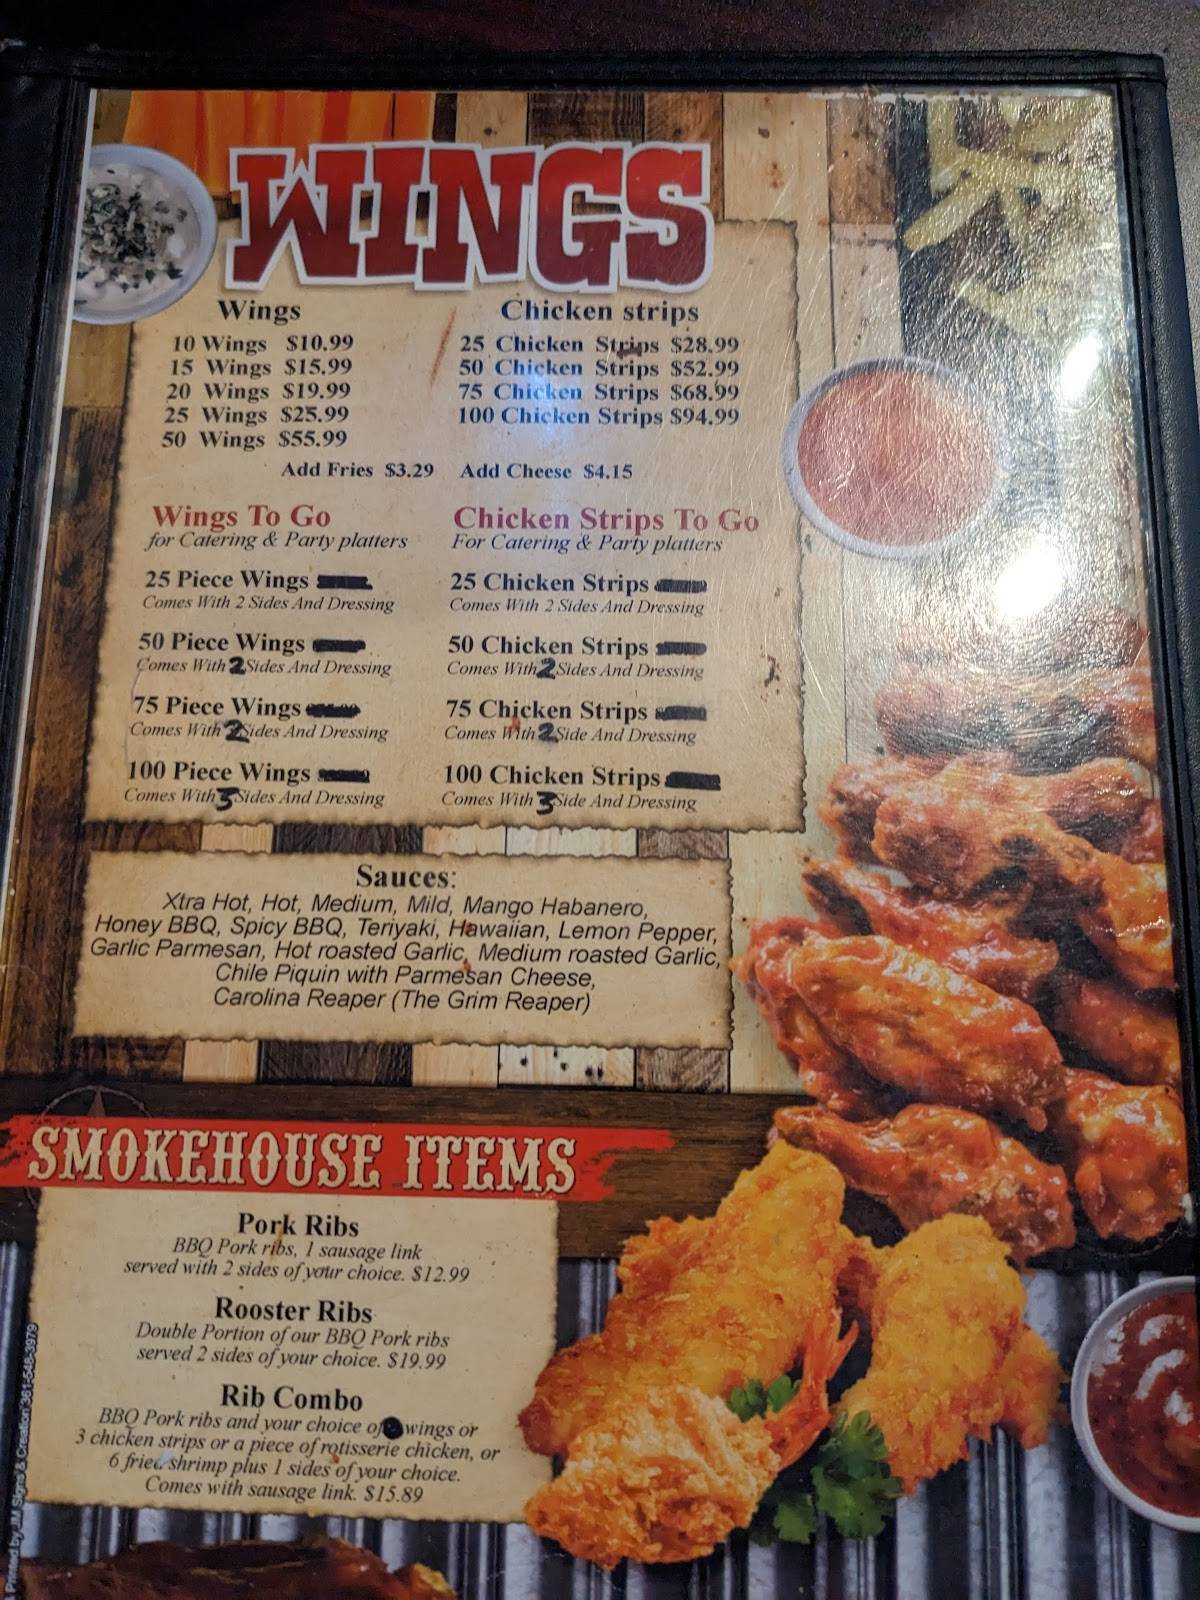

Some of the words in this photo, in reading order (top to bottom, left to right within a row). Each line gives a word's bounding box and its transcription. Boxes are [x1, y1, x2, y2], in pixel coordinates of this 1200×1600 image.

[224, 141, 714, 294] WINGS
[218, 300, 301, 324] Wings
[501, 300, 612, 321] Chicken
[623, 301, 699, 326] strips
[174, 336, 195, 351] 10
[202, 336, 267, 354] Wings
[286, 334, 354, 351] $10.99
[460, 336, 484, 351] 25
[496, 336, 583, 352] Chicken
[595, 337, 659, 356] Strips
[671, 338, 739, 352] $28.99
[171, 359, 194, 375] 15
[206, 359, 271, 378] Wings
[284, 359, 352, 376] $15.99
[459, 360, 483, 375] 50
[495, 360, 582, 376] Chicken
[595, 361, 659, 380] Strips
[670, 361, 739, 376] $52.99
[167, 383, 191, 399] 20
[204, 384, 269, 402] Wings
[282, 382, 351, 399] $19.99
[459, 384, 482, 399] 75
[494, 384, 582, 400] Chicken
[594, 384, 659, 404] Strips
[670, 384, 739, 400] $68.99
[164, 407, 189, 423] 25
[202, 408, 268, 426] Wings
[281, 406, 349, 423] $25.99
[458, 408, 494, 424] 100
[501, 408, 590, 424] Chicken
[598, 409, 663, 428] Strips
[670, 409, 739, 425] $94.99
[162, 431, 186, 448] 50
[200, 431, 265, 451] Wings
[279, 430, 347, 448] $55.99
[281, 462, 321, 478] Add
[328, 462, 373, 478] Fries
[385, 463, 434, 478] $3.29
[461, 464, 499, 478] Add
[507, 464, 572, 479] Cheese
[583, 464, 633, 479] $4.15
[152, 506, 238, 532] Wings
[249, 506, 280, 526] To
[291, 505, 331, 527] Go
[454, 507, 569, 529] Chicken
[580, 508, 664, 535] Strips
[675, 509, 708, 531] To
[719, 509, 759, 532] Go
[145, 532, 174, 551] for
[180, 532, 257, 549] Catering
[264, 532, 278, 547] &
[286, 532, 334, 550] Party
[338, 534, 408, 551] platters
[452, 534, 486, 549] For
[491, 535, 570, 554] Catering
[577, 536, 591, 551] &
[599, 536, 649, 554] Party
[652, 537, 723, 554] platters
[145, 571, 171, 588] 25
[178, 571, 234, 588] Piece
[241, 571, 309, 592] Wings
[451, 573, 476, 591] 25
[484, 573, 574, 591] Chicken
[583, 574, 649, 595] Strips
[143, 597, 192, 609] Comes
[198, 596, 231, 609] With
[236, 597, 245, 609] 2
[248, 597, 288, 610] Sides
[291, 597, 324, 611] And
[328, 598, 395, 614] Dressing
[450, 599, 499, 612] Comes
[506, 599, 539, 612] With
[544, 600, 554, 612] 2
[558, 600, 598, 613] Sides
[601, 600, 634, 614] And
[638, 601, 705, 617] Dressing
[128, 762, 166, 780] 100
[173, 762, 232, 782] Piece
[240, 763, 311, 786] Wings
[446, 766, 482, 784] 100
[490, 766, 584, 786] Chicken
[592, 767, 661, 790] Strips
[356, 864, 456, 888] Sauces:
[162, 892, 205, 910] Xtra
[212, 893, 252, 913] Hot,
[261, 894, 302, 913] Hot,
[311, 895, 397, 915] Medium,
[407, 896, 454, 916] Mild,
[463, 897, 534, 919] Mango
[540, 897, 648, 919] Habanero,
[94, 915, 161, 937] Honey
[168, 916, 221, 936] BBQ,
[230, 917, 287, 938] Spicy
[293, 918, 347, 938] BBQ,
[358, 919, 440, 940] Teriyaki,
[449, 921, 550, 941] Hawaiian,
[559, 922, 630, 940] Lemon
[638, 922, 717, 944] Pepper,
[90, 938, 149, 956] Garlic
[156, 939, 266, 961] Parmesan,
[275, 941, 310, 959] Hot
[318, 941, 396, 960] roasted
[404, 943, 468, 962] Garlic,
[478, 944, 561, 963] Medium
[568, 945, 647, 964] roasted
[655, 946, 721, 968] Garlic,
[216, 963, 268, 982] Chile
[274, 964, 340, 986] Piquin
[348, 965, 387, 983] with
[395, 967, 502, 986] Parmesan
[511, 967, 596, 990] Cheese,
[214, 987, 300, 1006] Carolina
[307, 988, 386, 1011] Reaper
[392, 990, 440, 1012] (The
[448, 991, 497, 1010] Grim
[505, 992, 591, 1014] Reaper)
[28, 1125, 383, 1189] SMOKEHOUSE
[404, 1134, 576, 1193] ITEMS
[239, 1212, 296, 1235] Pork
[305, 1215, 359, 1237] Ribs
[173, 1237, 213, 1257] BBQ
[218, 1238, 257, 1255] Pork
[262, 1241, 298, 1258] ribs,
[306, 1242, 313, 1257] 1
[319, 1244, 386, 1263] sausage
[391, 1244, 422, 1260] link
[123, 1259, 178, 1274] served
[183, 1260, 217, 1275] with
[223, 1261, 234, 1276] 2
[237, 1261, 278, 1277] sides
[284, 1263, 306, 1281] of
[302, 1266, 343, 1282] your
[347, 1266, 405, 1281] choice.
[412, 1266, 470, 1283] $12.99
[215, 1296, 310, 1321] Rooster
[317, 1300, 372, 1323] Ribs
[220, 1384, 265, 1408] Rib
[273, 1386, 363, 1412] Combo
[145, 1475, 202, 1494] Comes
[208, 1479, 243, 1495] with
[248, 1484, 316, 1504] sausage
[322, 1483, 357, 1501] link.
[364, 1485, 423, 1503] $15.89
